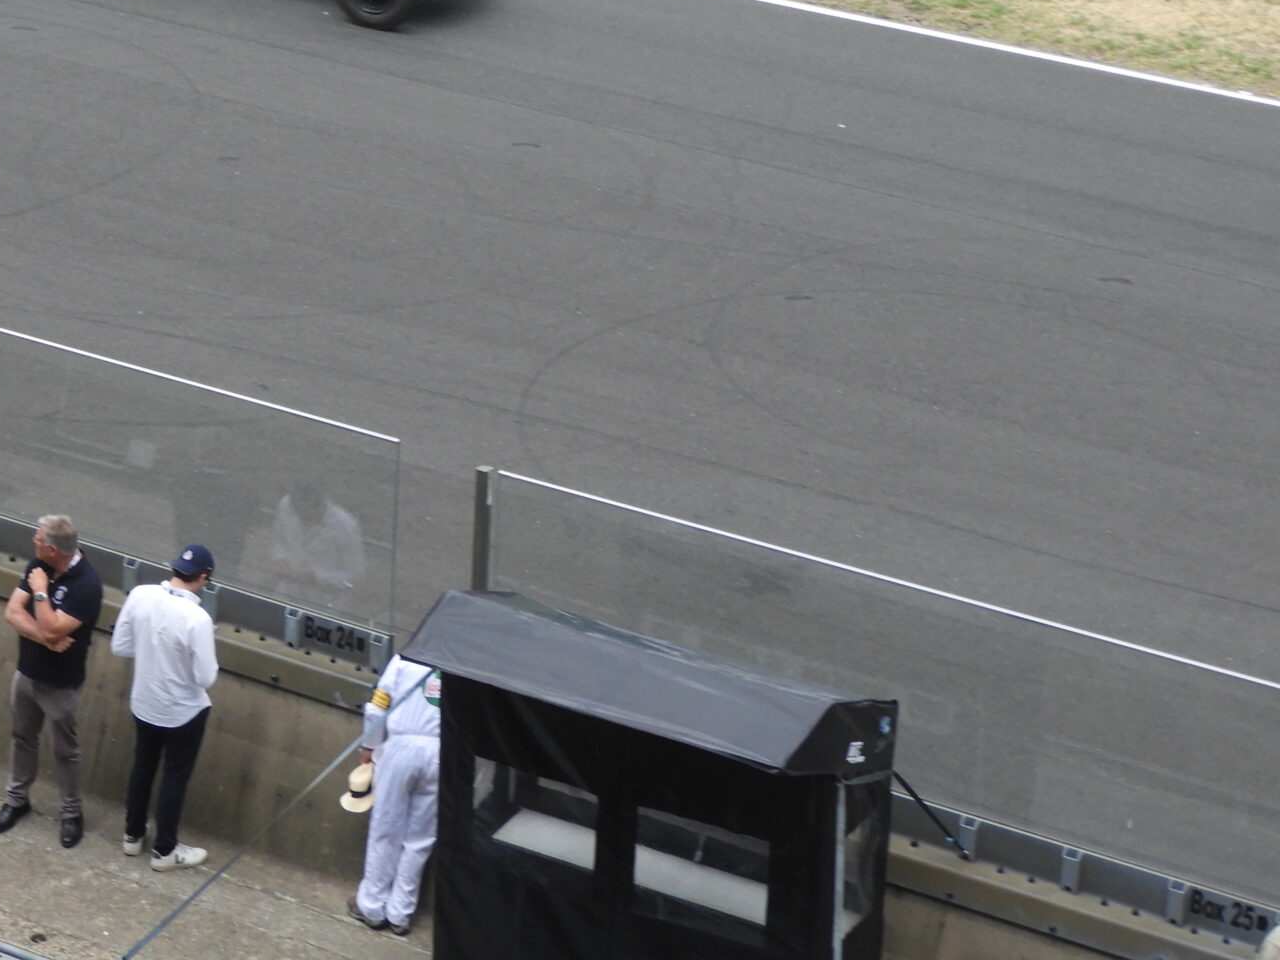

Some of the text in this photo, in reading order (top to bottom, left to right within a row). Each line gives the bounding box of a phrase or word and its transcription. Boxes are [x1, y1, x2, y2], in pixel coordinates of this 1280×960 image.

[305, 616, 355, 652] Box 24
[1190, 889, 1254, 931] Box 25
